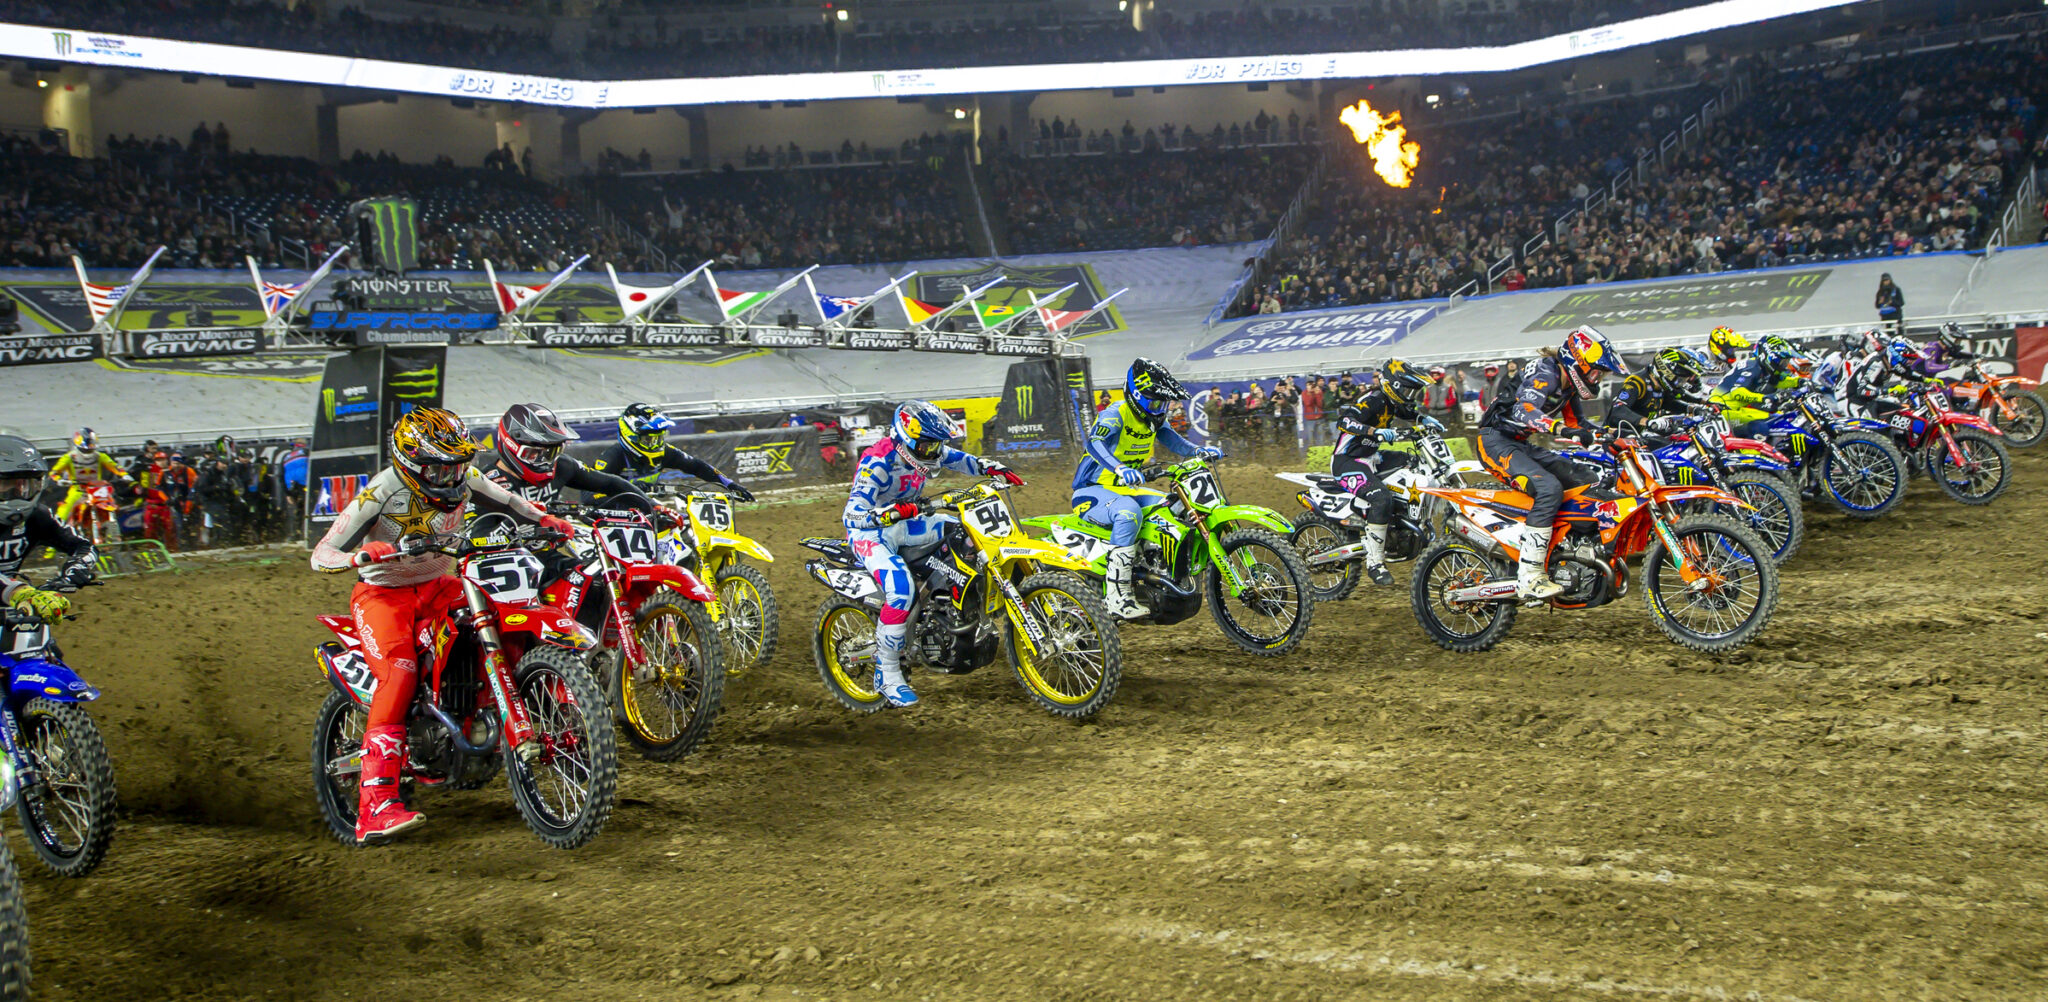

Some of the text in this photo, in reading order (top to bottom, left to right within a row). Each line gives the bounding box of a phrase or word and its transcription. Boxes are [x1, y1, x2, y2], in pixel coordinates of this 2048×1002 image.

[351, 278, 452, 296] MONSTER
[309, 312, 499, 329] SUPERCROSS
[1287, 307, 1428, 331] YAMAHA
[27, 336, 92, 348] MOUNTAIN
[161, 330, 256, 342] ROCKY MOUNTAIN
[366, 330, 451, 343] Championship
[1254, 327, 1398, 350] YAMAHA
[1430, 441, 1451, 458] 27
[1189, 474, 1221, 505] 21
[699, 503, 730, 526] 45
[1319, 495, 1350, 514] 27
[975, 503, 1011, 535] 94
[606, 528, 655, 560] 14
[477, 556, 542, 595] 51
[925, 555, 968, 587] PROGRESSIVE
[341, 652, 377, 691] 51
[488, 672, 508, 715] MOTOREX
[502, 674, 525, 719] DUOP
[3, 710, 30, 765] DUNOP
